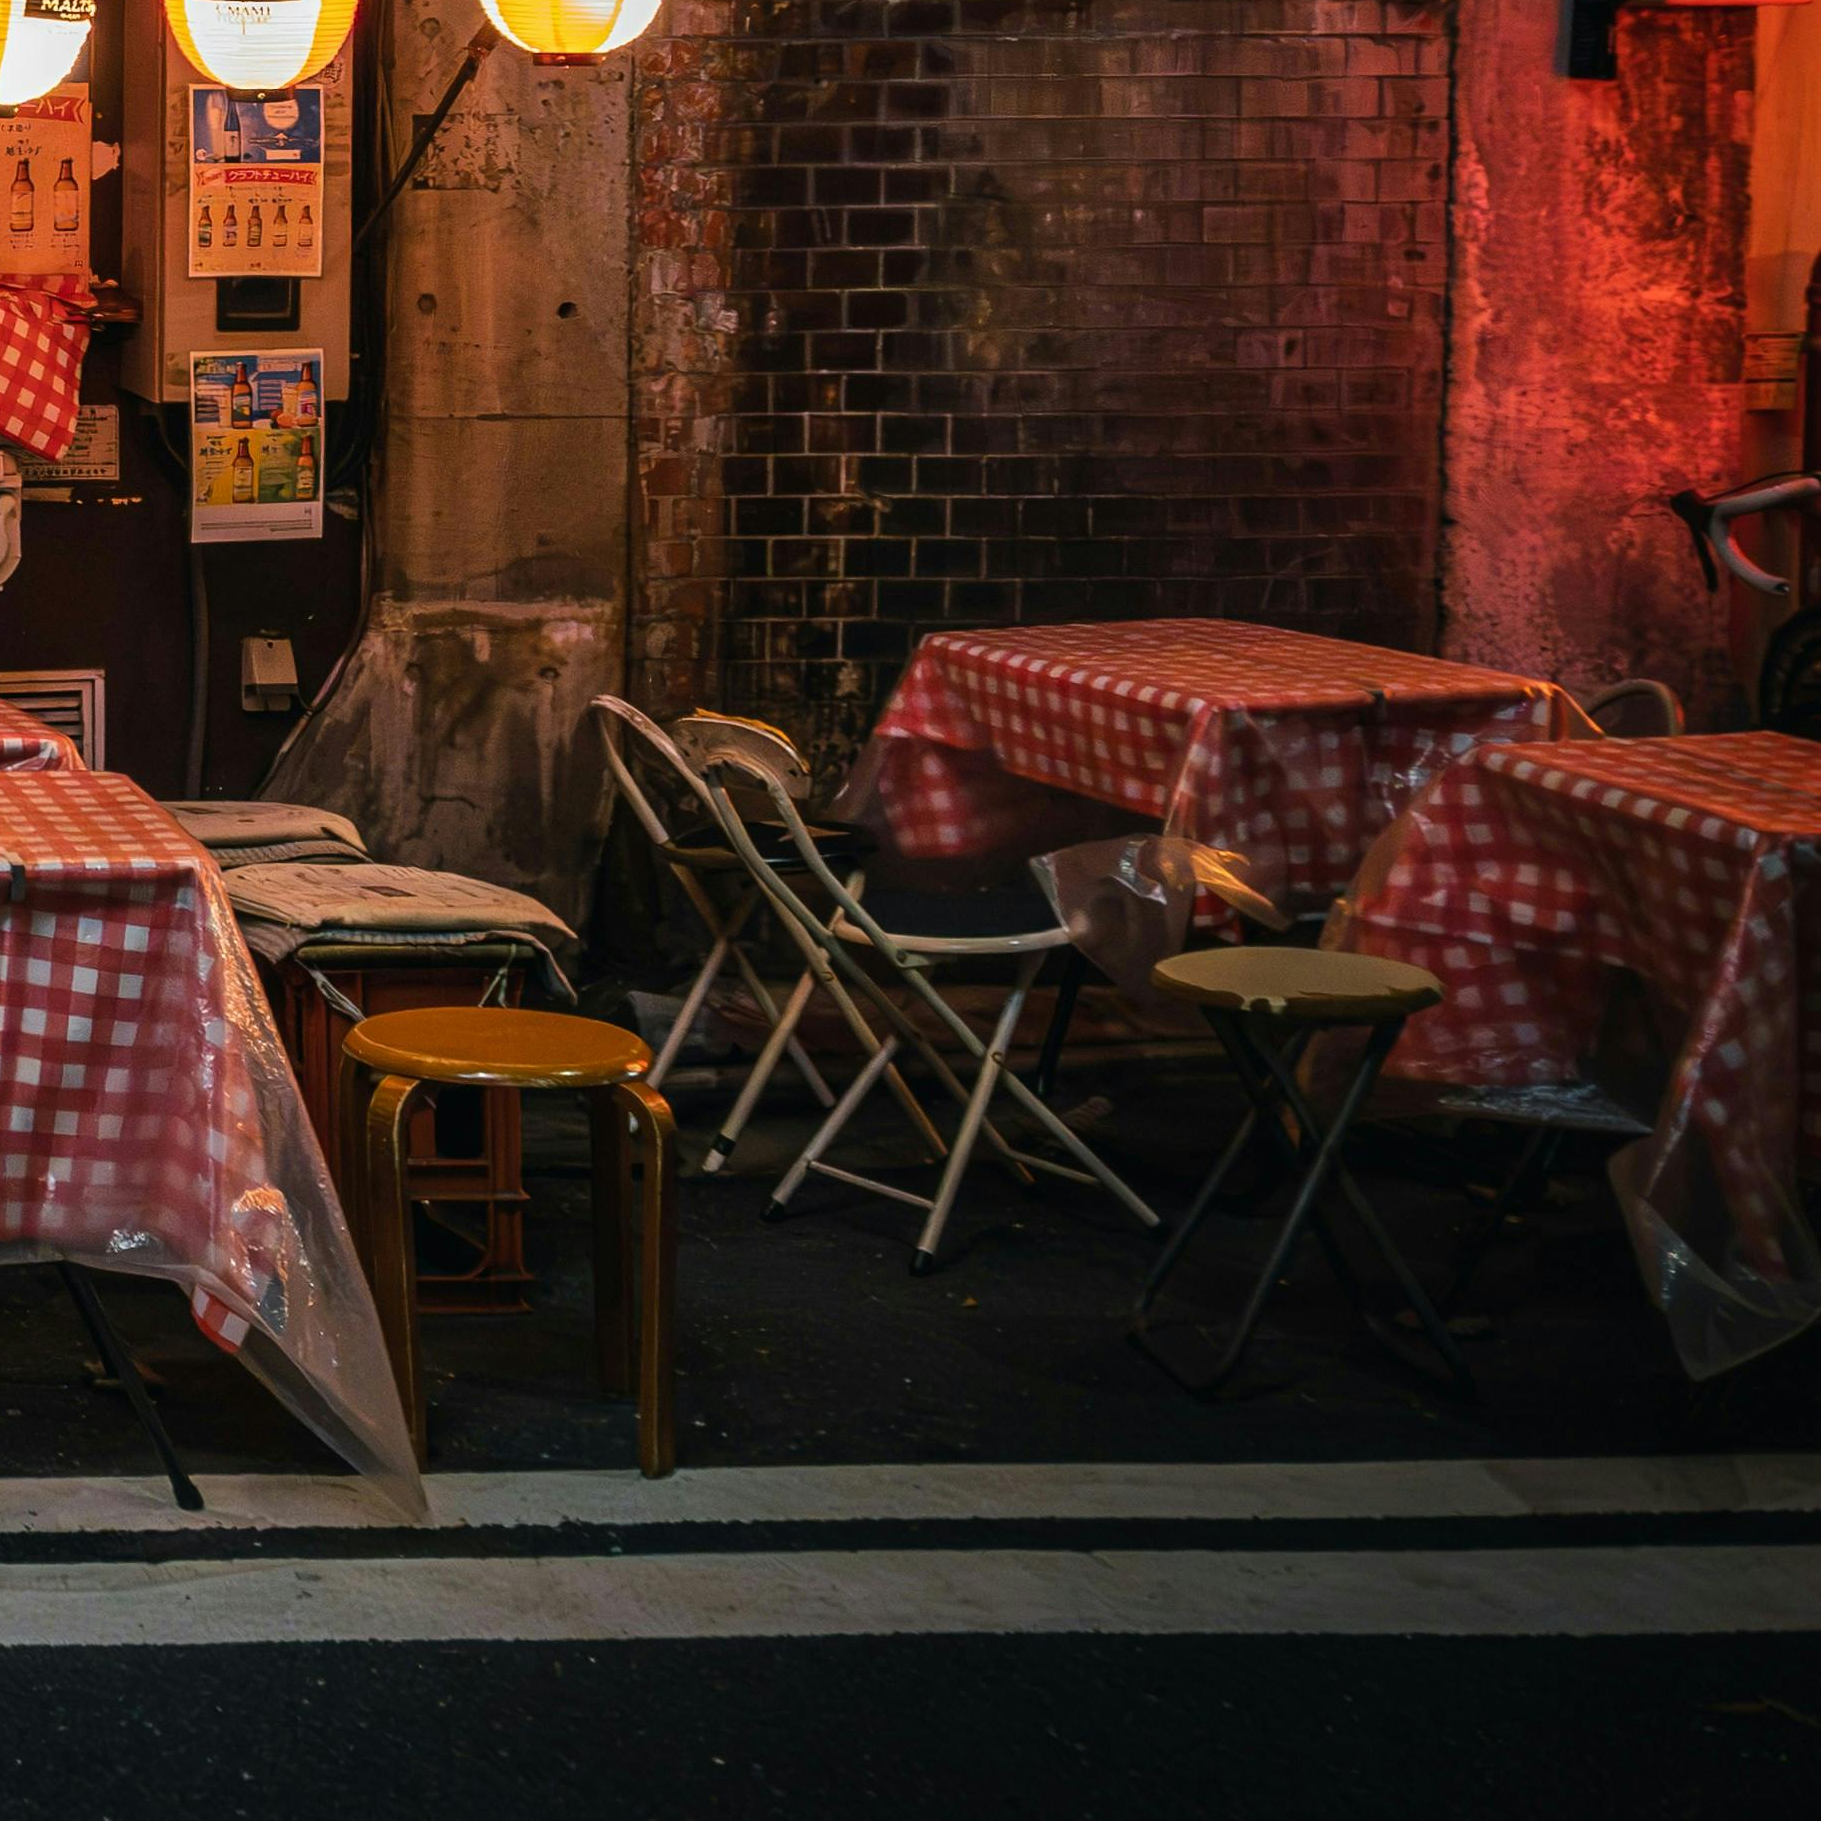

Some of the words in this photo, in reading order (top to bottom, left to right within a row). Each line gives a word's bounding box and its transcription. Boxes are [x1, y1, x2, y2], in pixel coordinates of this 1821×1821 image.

[229, 170, 308, 182] クラフトチューハイ
